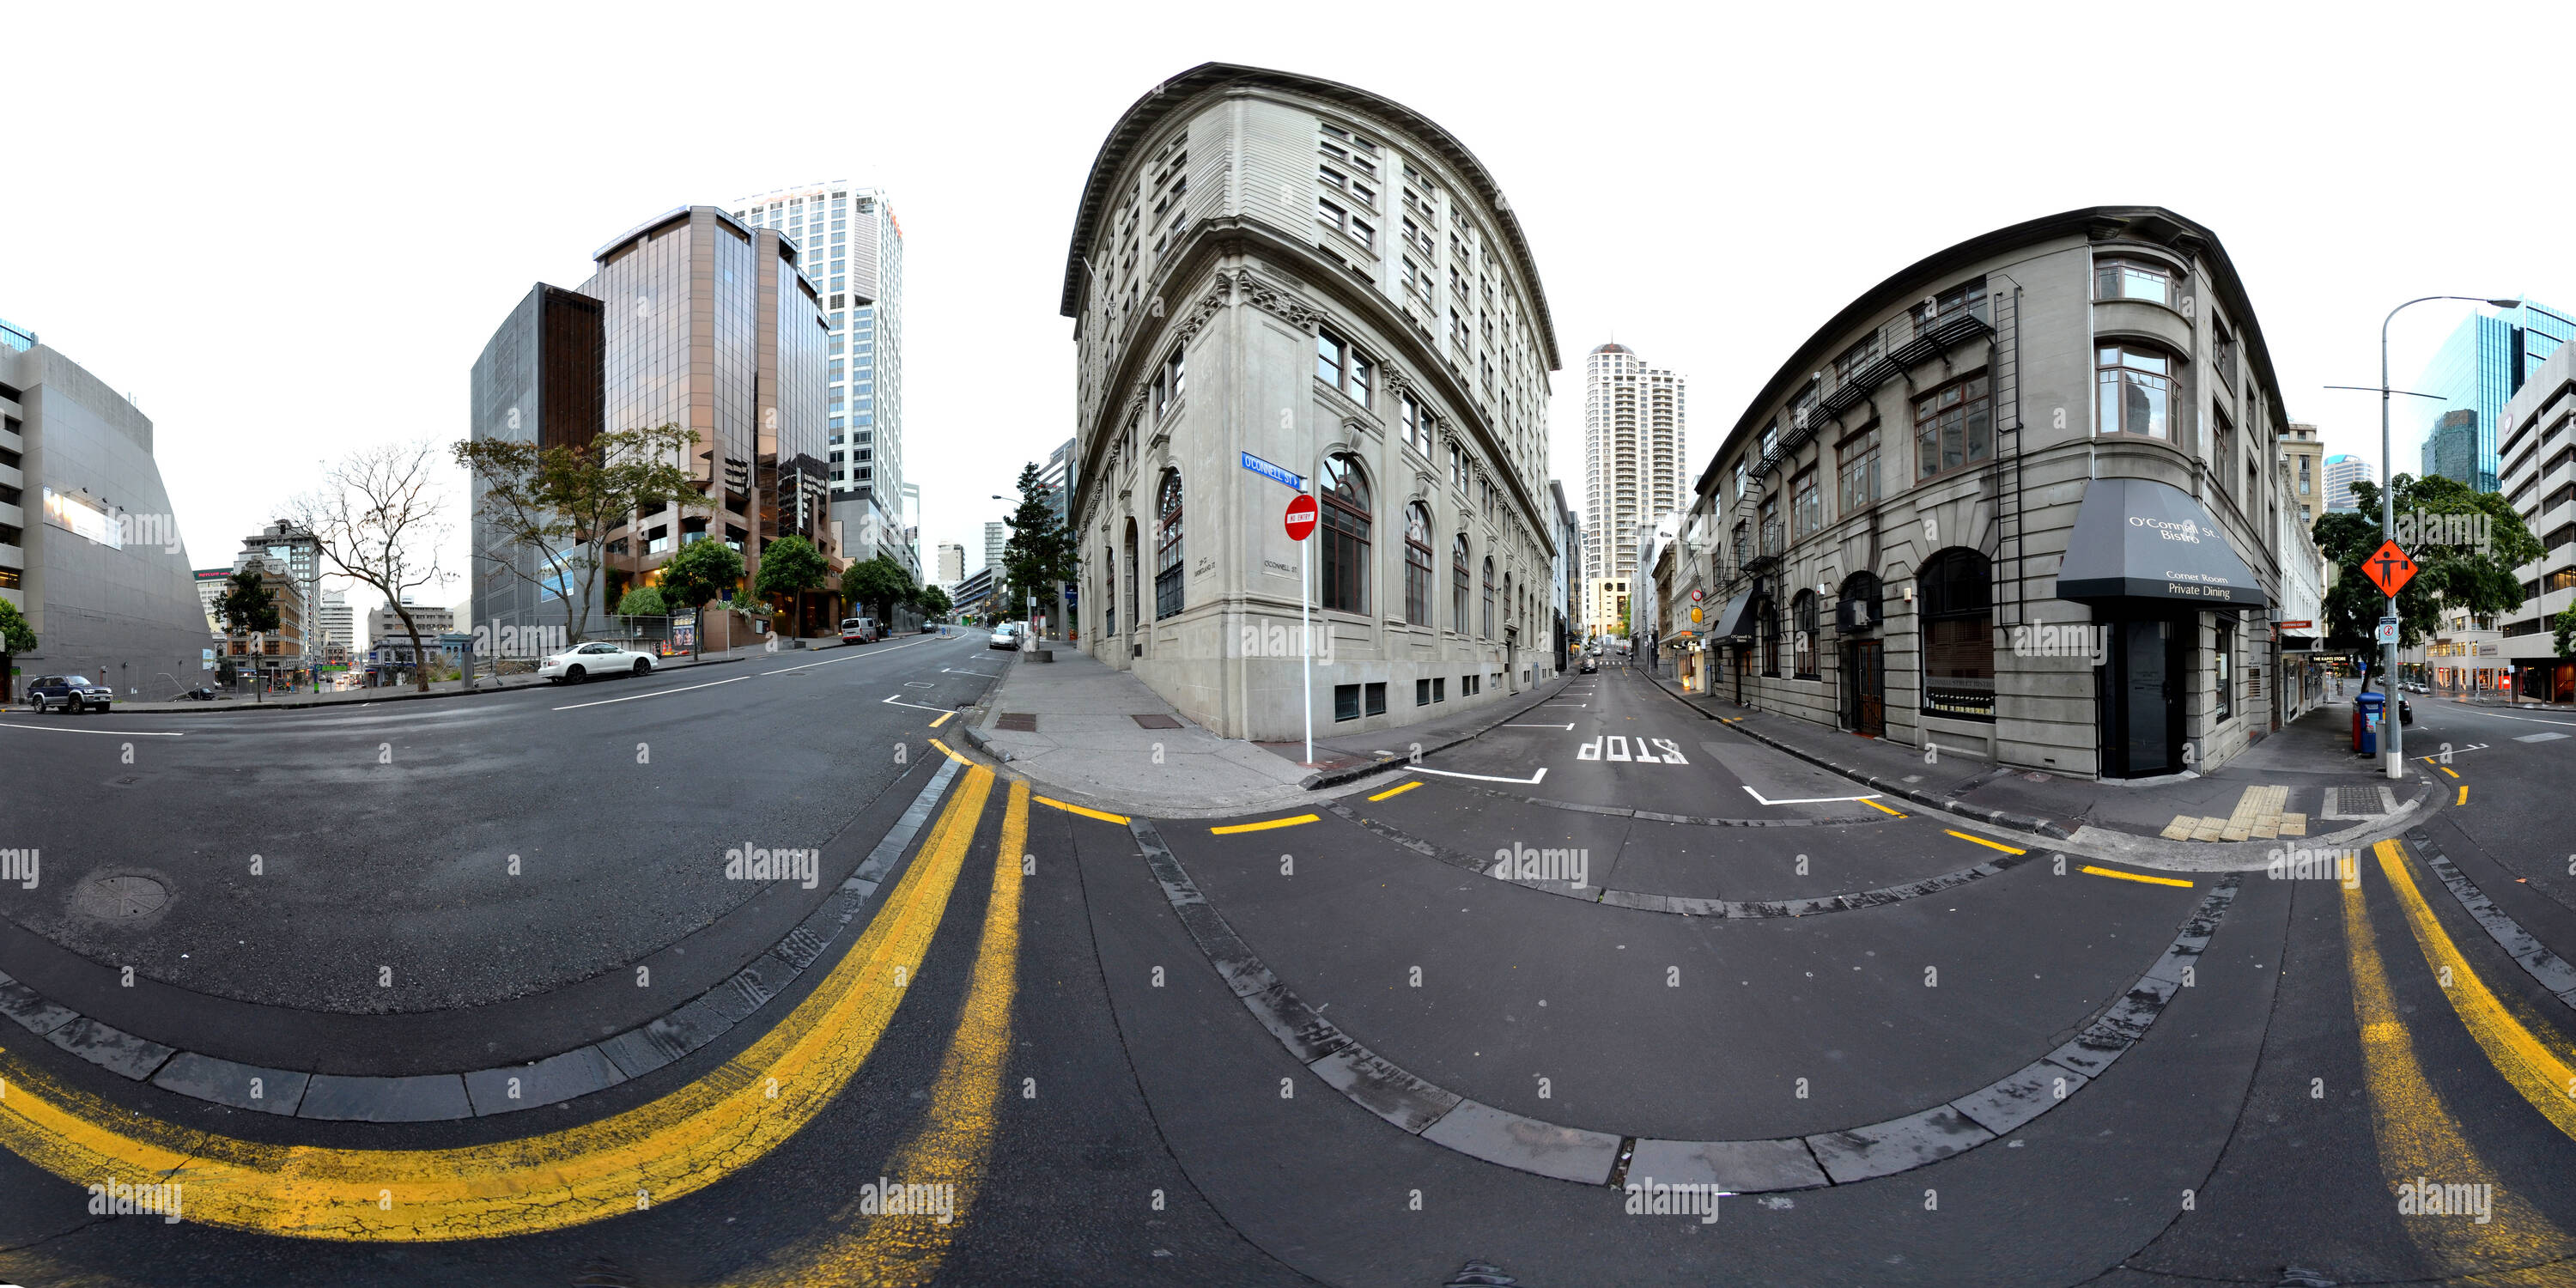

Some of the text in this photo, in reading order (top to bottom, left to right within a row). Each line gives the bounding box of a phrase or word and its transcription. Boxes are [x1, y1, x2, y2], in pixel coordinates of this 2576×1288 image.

[1244, 455, 1293, 485] O'CONNELL ST
[1297, 513, 1311, 522] ENTRY
[2129, 516, 2221, 539] O'Connell St.
[2160, 529, 2200, 544] Bistro
[1263, 559, 1291, 572] O'CONNELL
[2166, 570, 2228, 585] Corner Room
[2168, 582, 2231, 601] Private Dining
[1577, 735, 1690, 765] STOP
